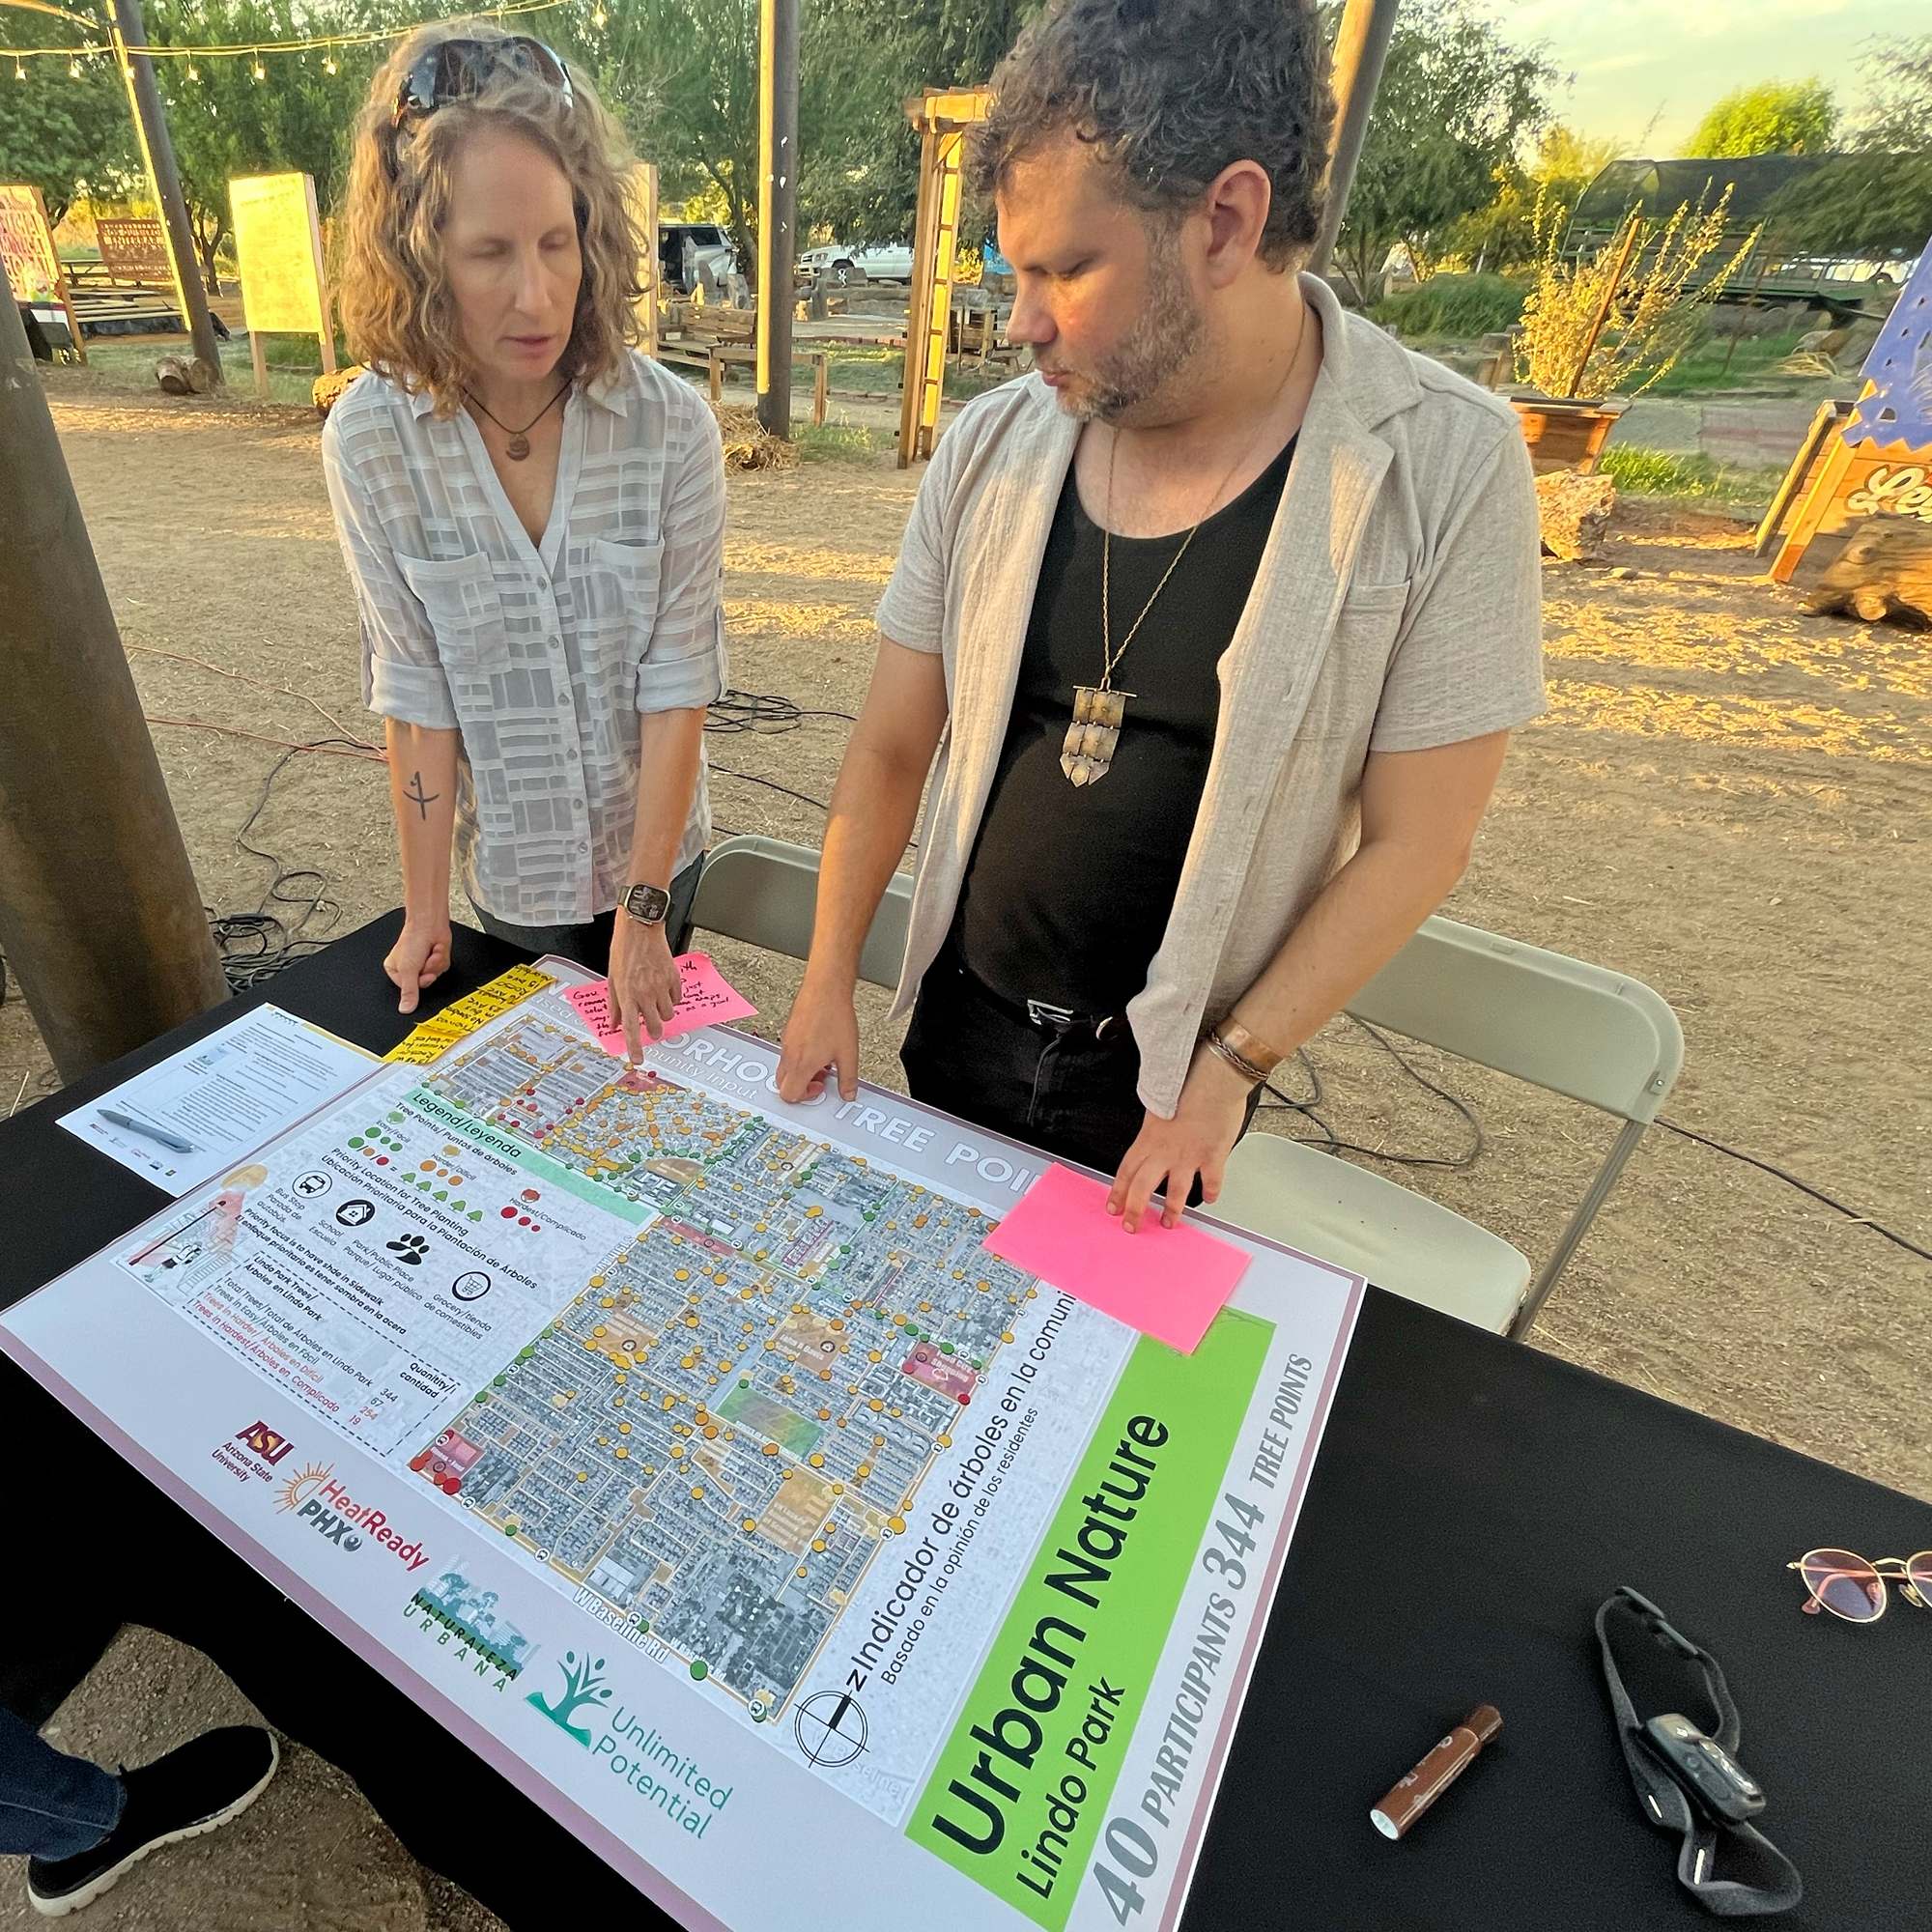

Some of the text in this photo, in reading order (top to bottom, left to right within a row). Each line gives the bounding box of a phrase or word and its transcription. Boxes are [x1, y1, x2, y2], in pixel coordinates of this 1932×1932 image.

[1844, 464, 1932, 523] Le
[680, 960, 697, 973] ith
[530, 992, 574, 1019] ased
[642, 1047, 704, 1080] munity
[706, 1067, 759, 1100] Input
[396, 1102, 517, 1176] Tree Points/ Puntos de árboles
[412, 1094, 522, 1158] Legend/Leyenda
[835, 1100, 1041, 1196] TREE POI
[266, 1194, 302, 1221] Parada de
[275, 1187, 305, 1210] Bus Stop
[309, 1226, 337, 1247] Escuela
[318, 1219, 345, 1238] School
[321, 1154, 362, 1187] Ubicación
[402, 1206, 428, 1227] para
[427, 1219, 439, 1234] la
[437, 1225, 486, 1261] Plantación
[486, 1256, 501, 1267] de
[499, 1260, 538, 1290] Árboles
[331, 1148, 469, 1237] Priority Location for Tree Planting
[509, 1197, 587, 1241] Hardest/Complicado
[242, 1217, 271, 1243] enfoque
[270, 1237, 306, 1267] prioritario
[305, 1263, 314, 1273] es
[313, 1268, 335, 1288] tener
[334, 1283, 363, 1307] sombra
[362, 1304, 375, 1315] en
[374, 1310, 384, 1321] la
[383, 1317, 407, 1335] acera
[243, 1262, 323, 1321] Árboles en Lindo Park
[244, 1208, 272, 1232] Priority
[270, 1225, 292, 1244] focus
[290, 1239, 297, 1250] is
[296, 1243, 304, 1254] to
[304, 1248, 324, 1267] have
[340, 1270, 349, 1283] in
[349, 1276, 384, 1307] Sidewalk
[253, 1256, 319, 1301] Lindo Park Trees/
[353, 1238, 414, 1283] Park/Public Place
[372, 1264, 393, 1284] Lugar
[392, 1278, 423, 1302] público
[203, 1292, 223, 1310] Trees
[222, 1306, 232, 1317] in
[230, 1309, 262, 1338] Harder/
[289, 1356, 300, 1368] en
[359, 1406, 379, 1421] 254
[213, 1284, 234, 1302] Trees
[233, 1298, 242, 1309] in
[287, 1339, 299, 1350] en
[370, 1396, 384, 1407] 67
[224, 1277, 399, 1403] Total Trees/Total de Árboles en Lindo Park 344
[423, 1301, 483, 1340] de comestibles
[433, 1293, 493, 1332] Grocery/tienda
[192, 1299, 213, 1318] Trees
[212, 1314, 221, 1324] in
[278, 1365, 291, 1378] en
[291, 1376, 340, 1413] Complicado
[349, 1414, 361, 1426] 19
[399, 1370, 440, 1400] cantidad
[212, 1450, 251, 1483] University
[221, 1441, 273, 1483] Arizona State
[234, 1420, 295, 1466] ASU
[851, 1292, 1077, 1671] Indicador de árboles en la comuni
[318, 1479, 430, 1572] HeatReady
[880, 1407, 1038, 1686] Basado en la opinión de los residentes
[403, 1604, 508, 1693] URBANA
[411, 1592, 519, 1682] NATURALEZA
[931, 1413, 1170, 1856] Urban Nature
[1093, 1352, 1313, 1927] 40 PARTICIPANTS 344 TREE POINTS
[591, 1734, 713, 1839] Potential
[611, 1706, 733, 1811] Unlimited
[1015, 1675, 1126, 1899] Lindo Park
